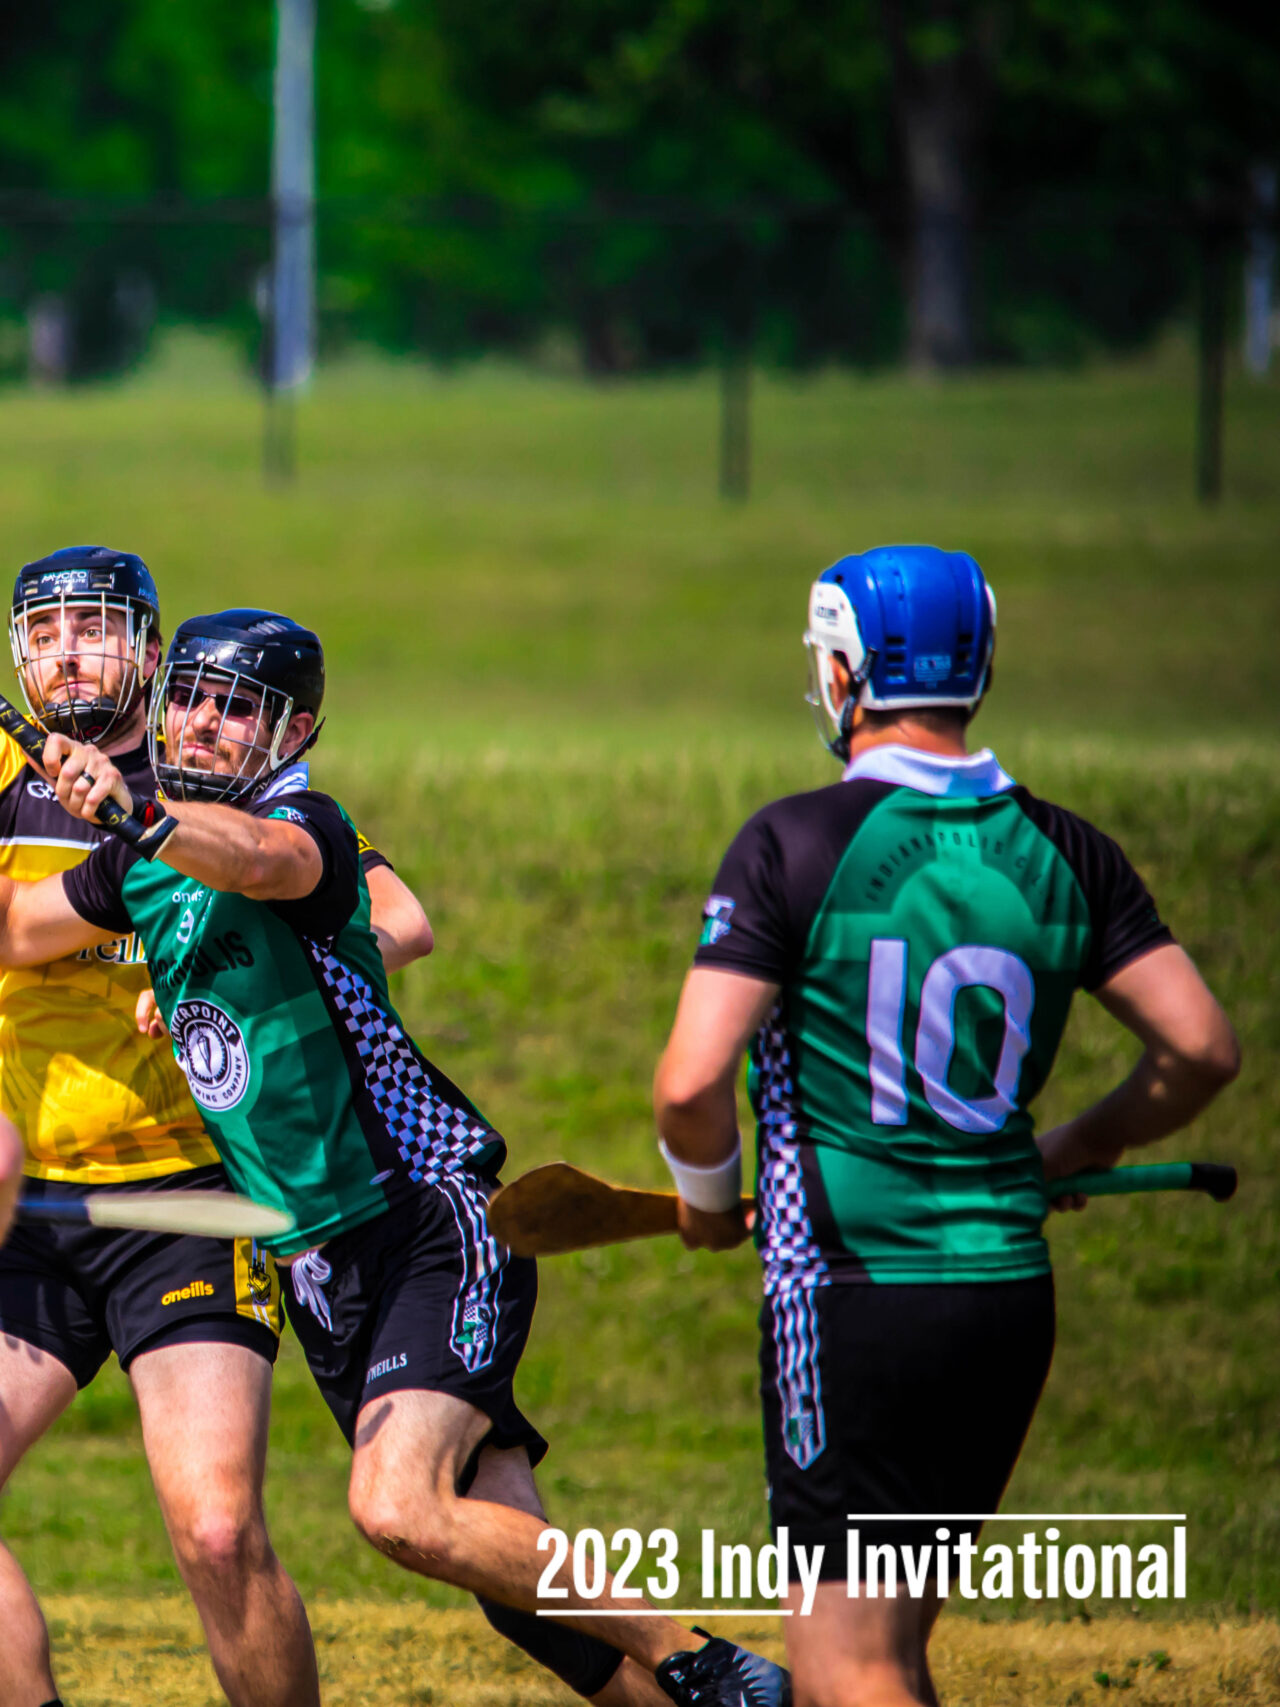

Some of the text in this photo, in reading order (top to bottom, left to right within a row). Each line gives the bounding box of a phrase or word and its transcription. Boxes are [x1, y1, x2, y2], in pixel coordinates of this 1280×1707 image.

[866, 938, 1036, 1134] 10
[222, 1055, 243, 1100] COMPANY
[161, 1280, 215, 1306] oneills
